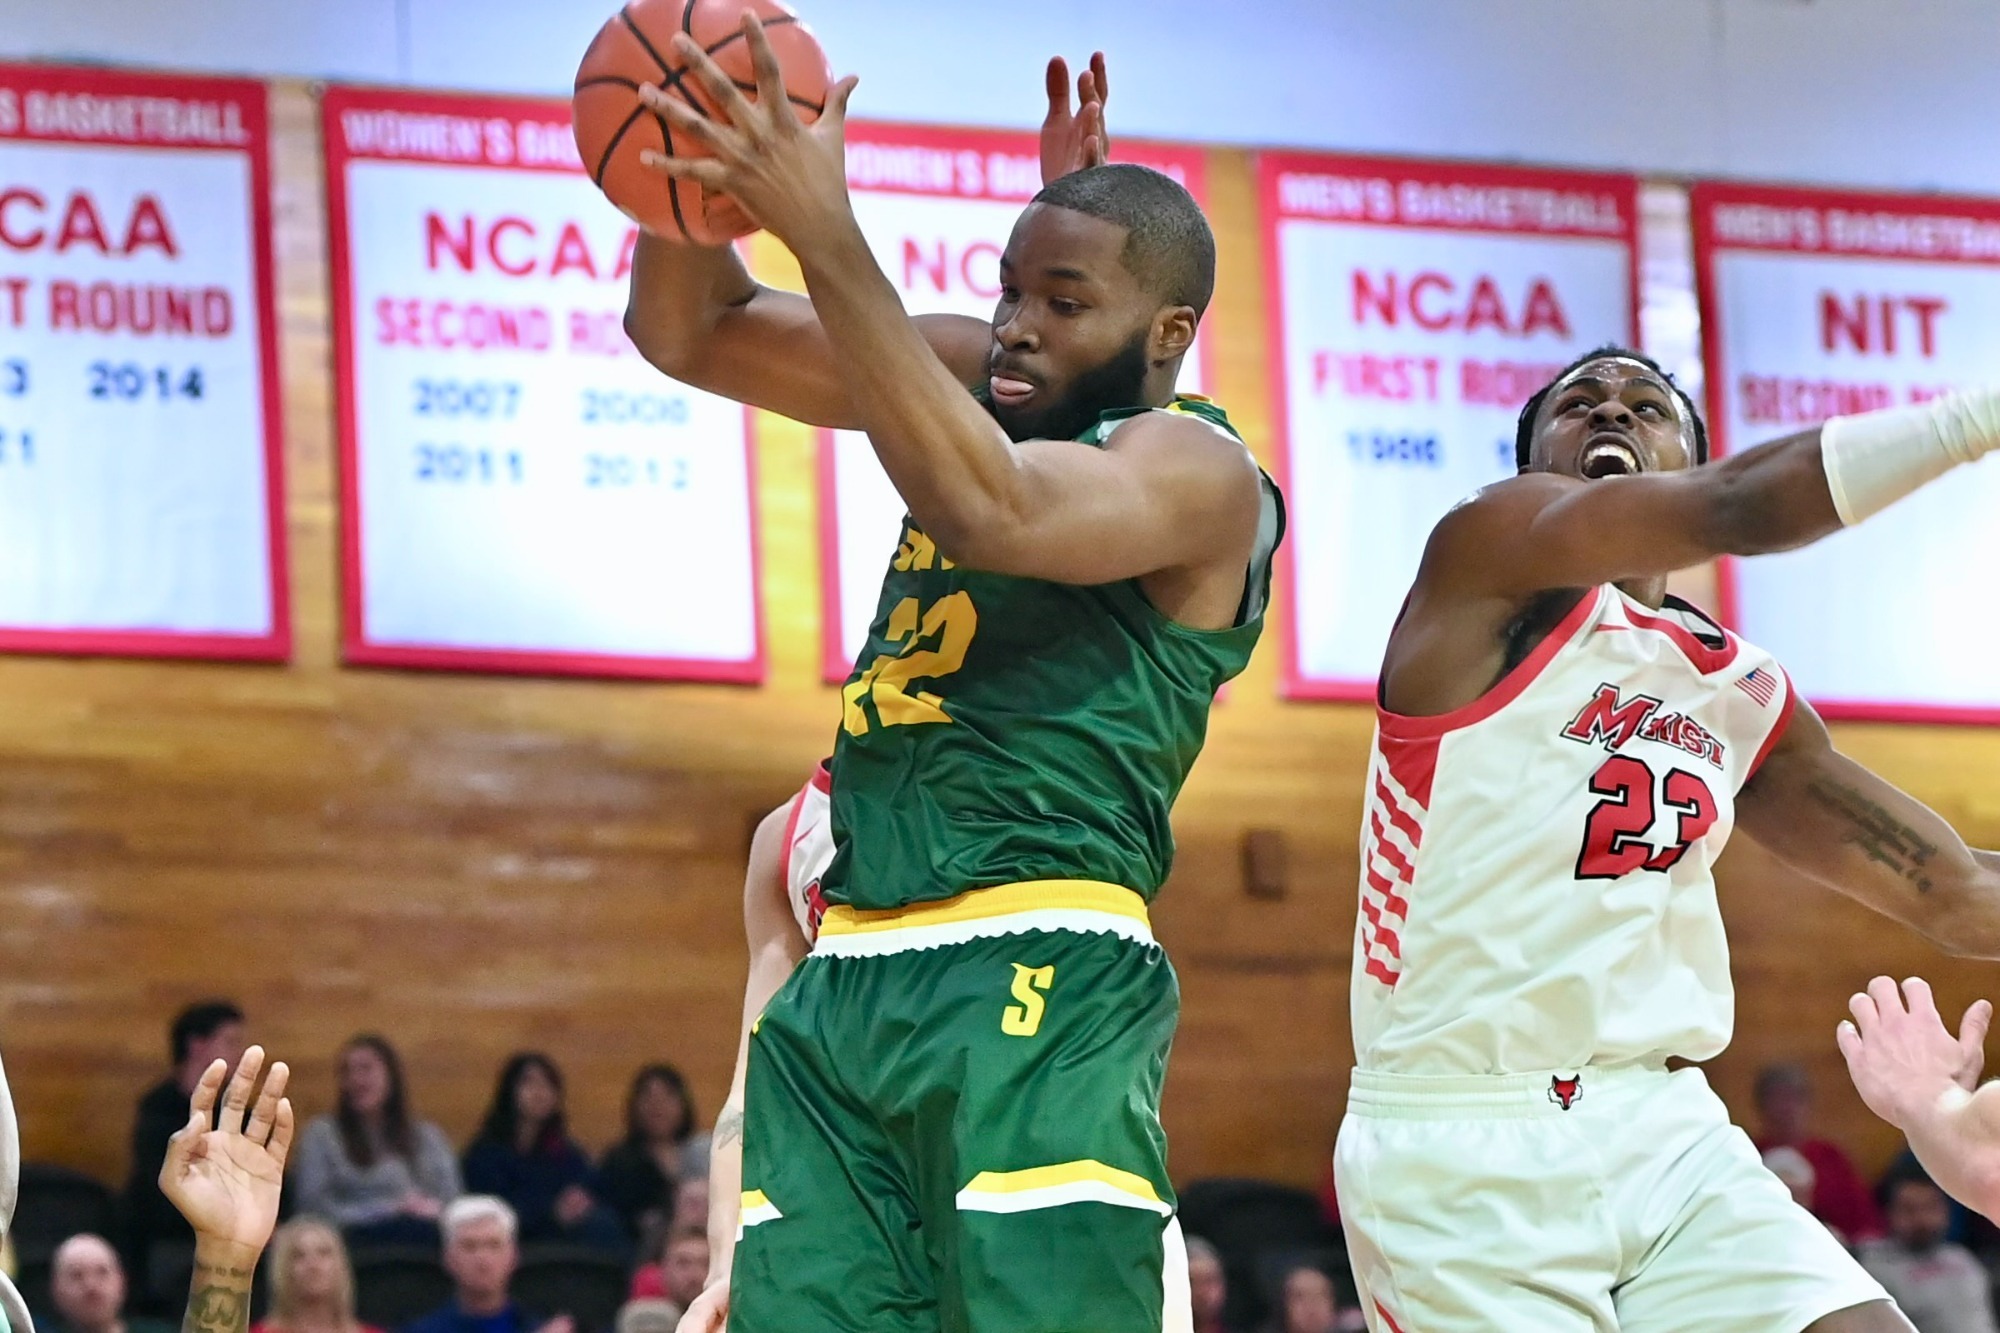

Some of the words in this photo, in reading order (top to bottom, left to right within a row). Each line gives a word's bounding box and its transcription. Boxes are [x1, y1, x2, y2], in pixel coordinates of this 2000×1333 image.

[49, 281, 234, 338] ROUND
[376, 297, 551, 352] SECOND
[1351, 270, 1571, 341] NCAA
[1821, 290, 1948, 358] NIT
[87, 360, 205, 402] 2014
[412, 379, 521, 418] 2007
[1313, 352, 1440, 404] FIRST
[413, 443, 524, 484] 2011
[1574, 754, 1719, 881] 23
[1000, 961, 1055, 1037] S
